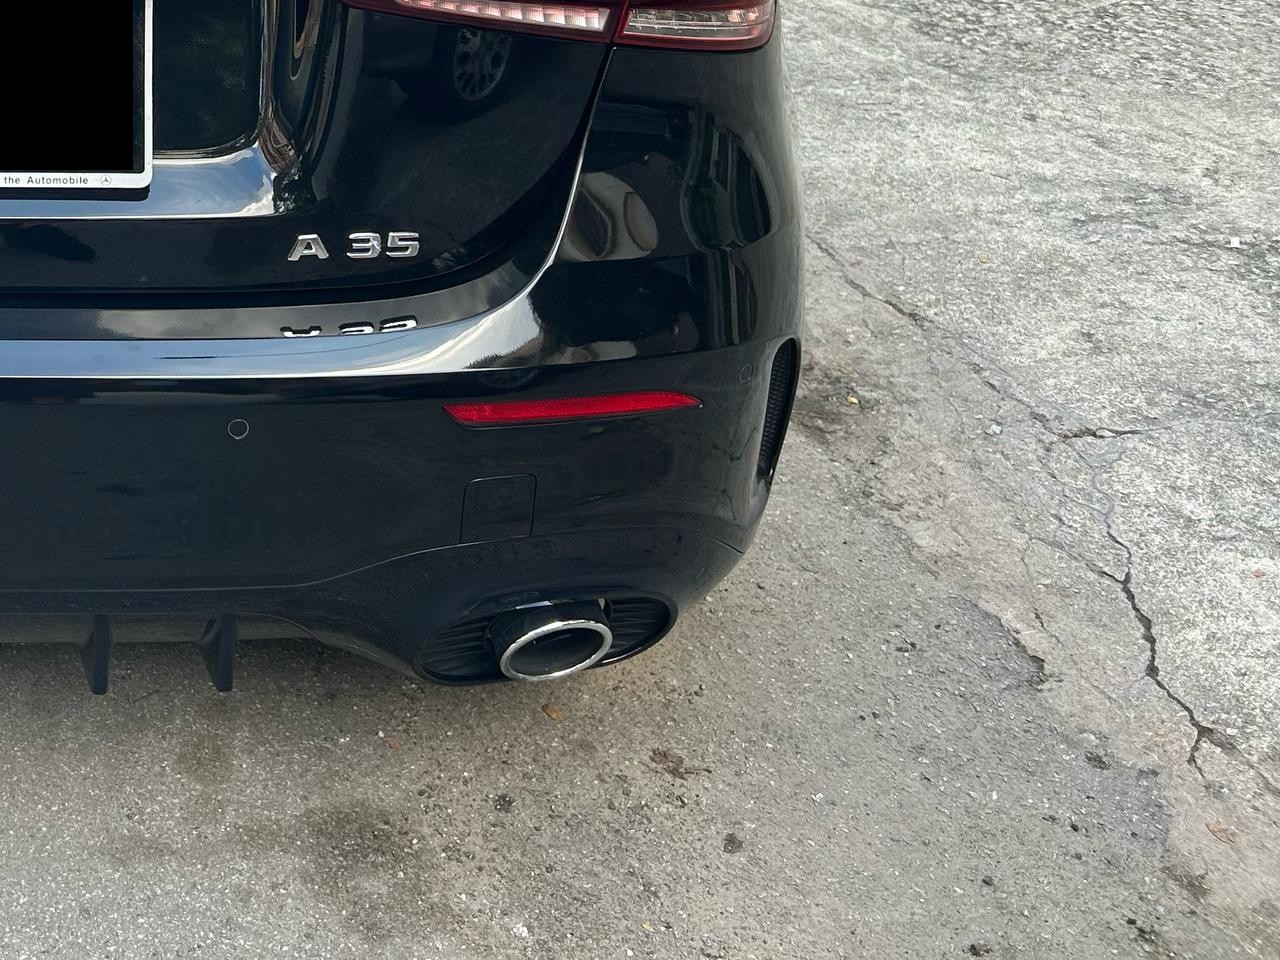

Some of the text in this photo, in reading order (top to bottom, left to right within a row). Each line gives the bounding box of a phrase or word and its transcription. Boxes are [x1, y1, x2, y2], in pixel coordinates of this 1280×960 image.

[4, 175, 21, 185] the
[27, 175, 89, 185] Automobile
[287, 231, 420, 262] A 35
